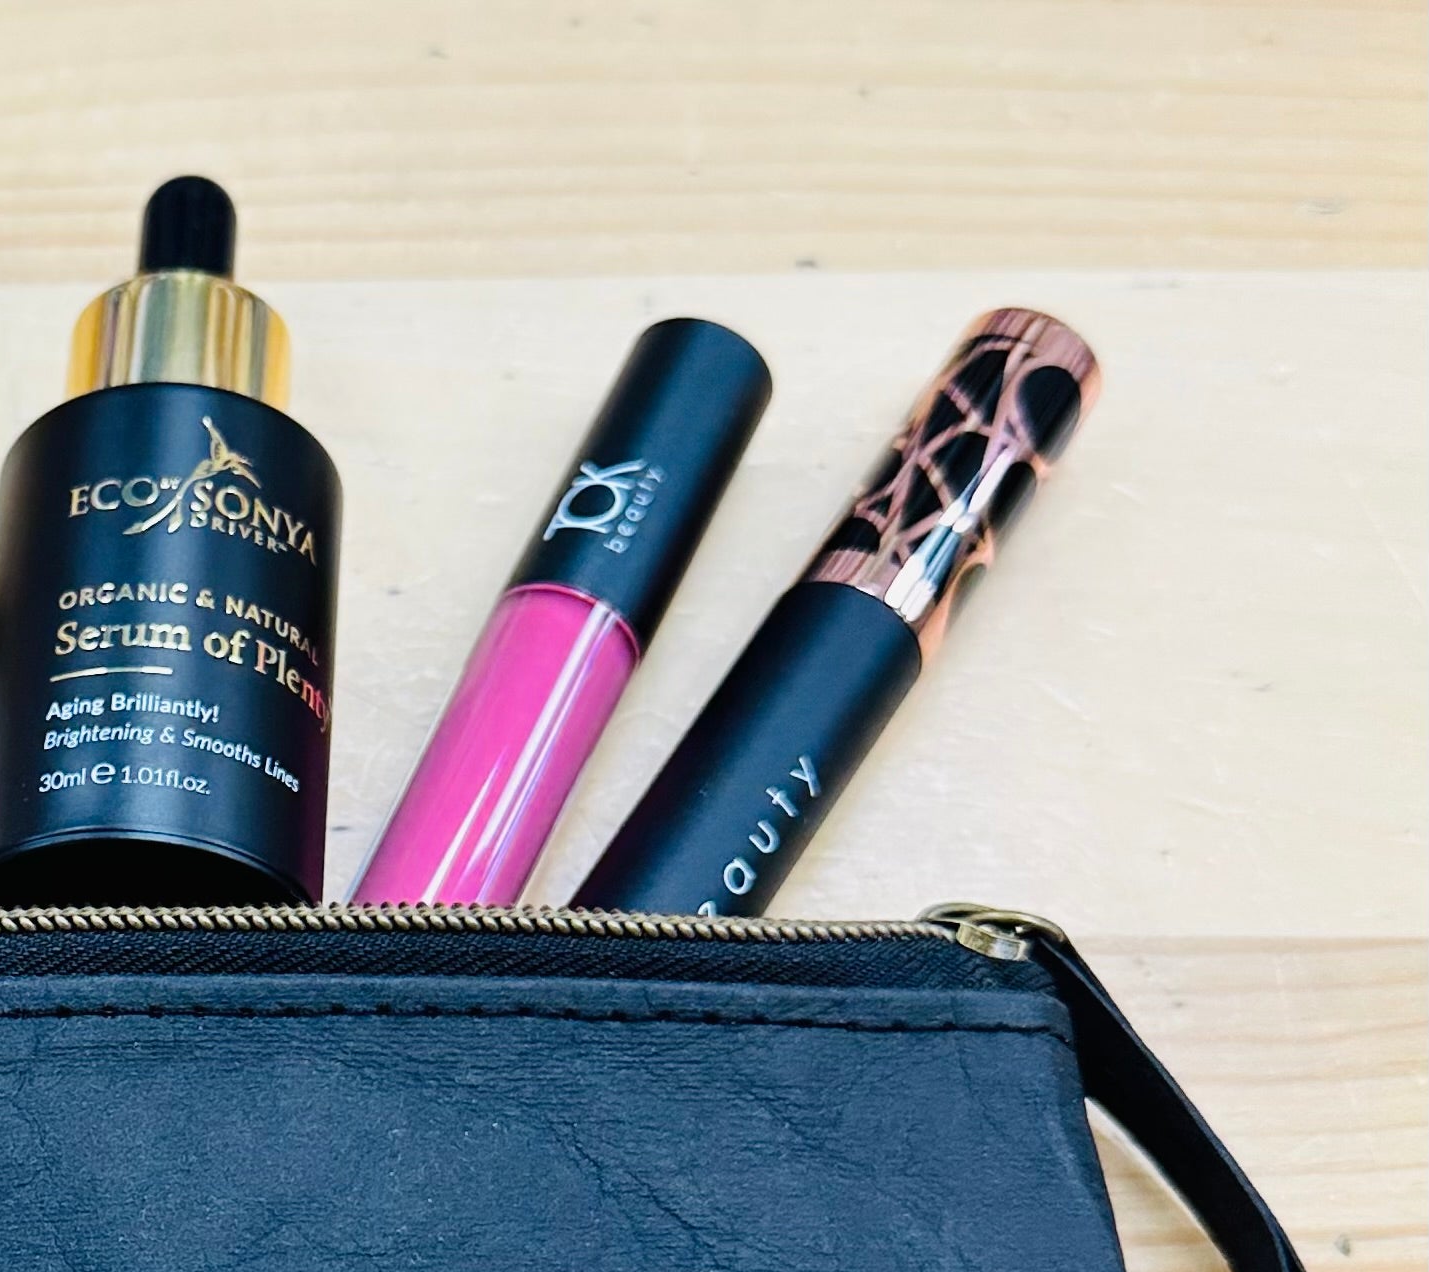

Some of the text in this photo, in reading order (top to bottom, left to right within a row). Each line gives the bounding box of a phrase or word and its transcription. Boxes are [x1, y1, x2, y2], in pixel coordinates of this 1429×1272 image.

[68, 477, 160, 518] ECO
[190, 480, 317, 567] SONYA
[603, 464, 667, 554] beauty
[59, 582, 319, 667] ORGANIC & NATURAL
[45, 691, 220, 724] Aging Brilliantly!
[55, 621, 333, 733] Serum of Plenty
[38, 767, 86, 793] 30ml
[121, 765, 211, 795] 1.01fl.oz.
[44, 723, 300, 793] Brightening & Smooths Lines
